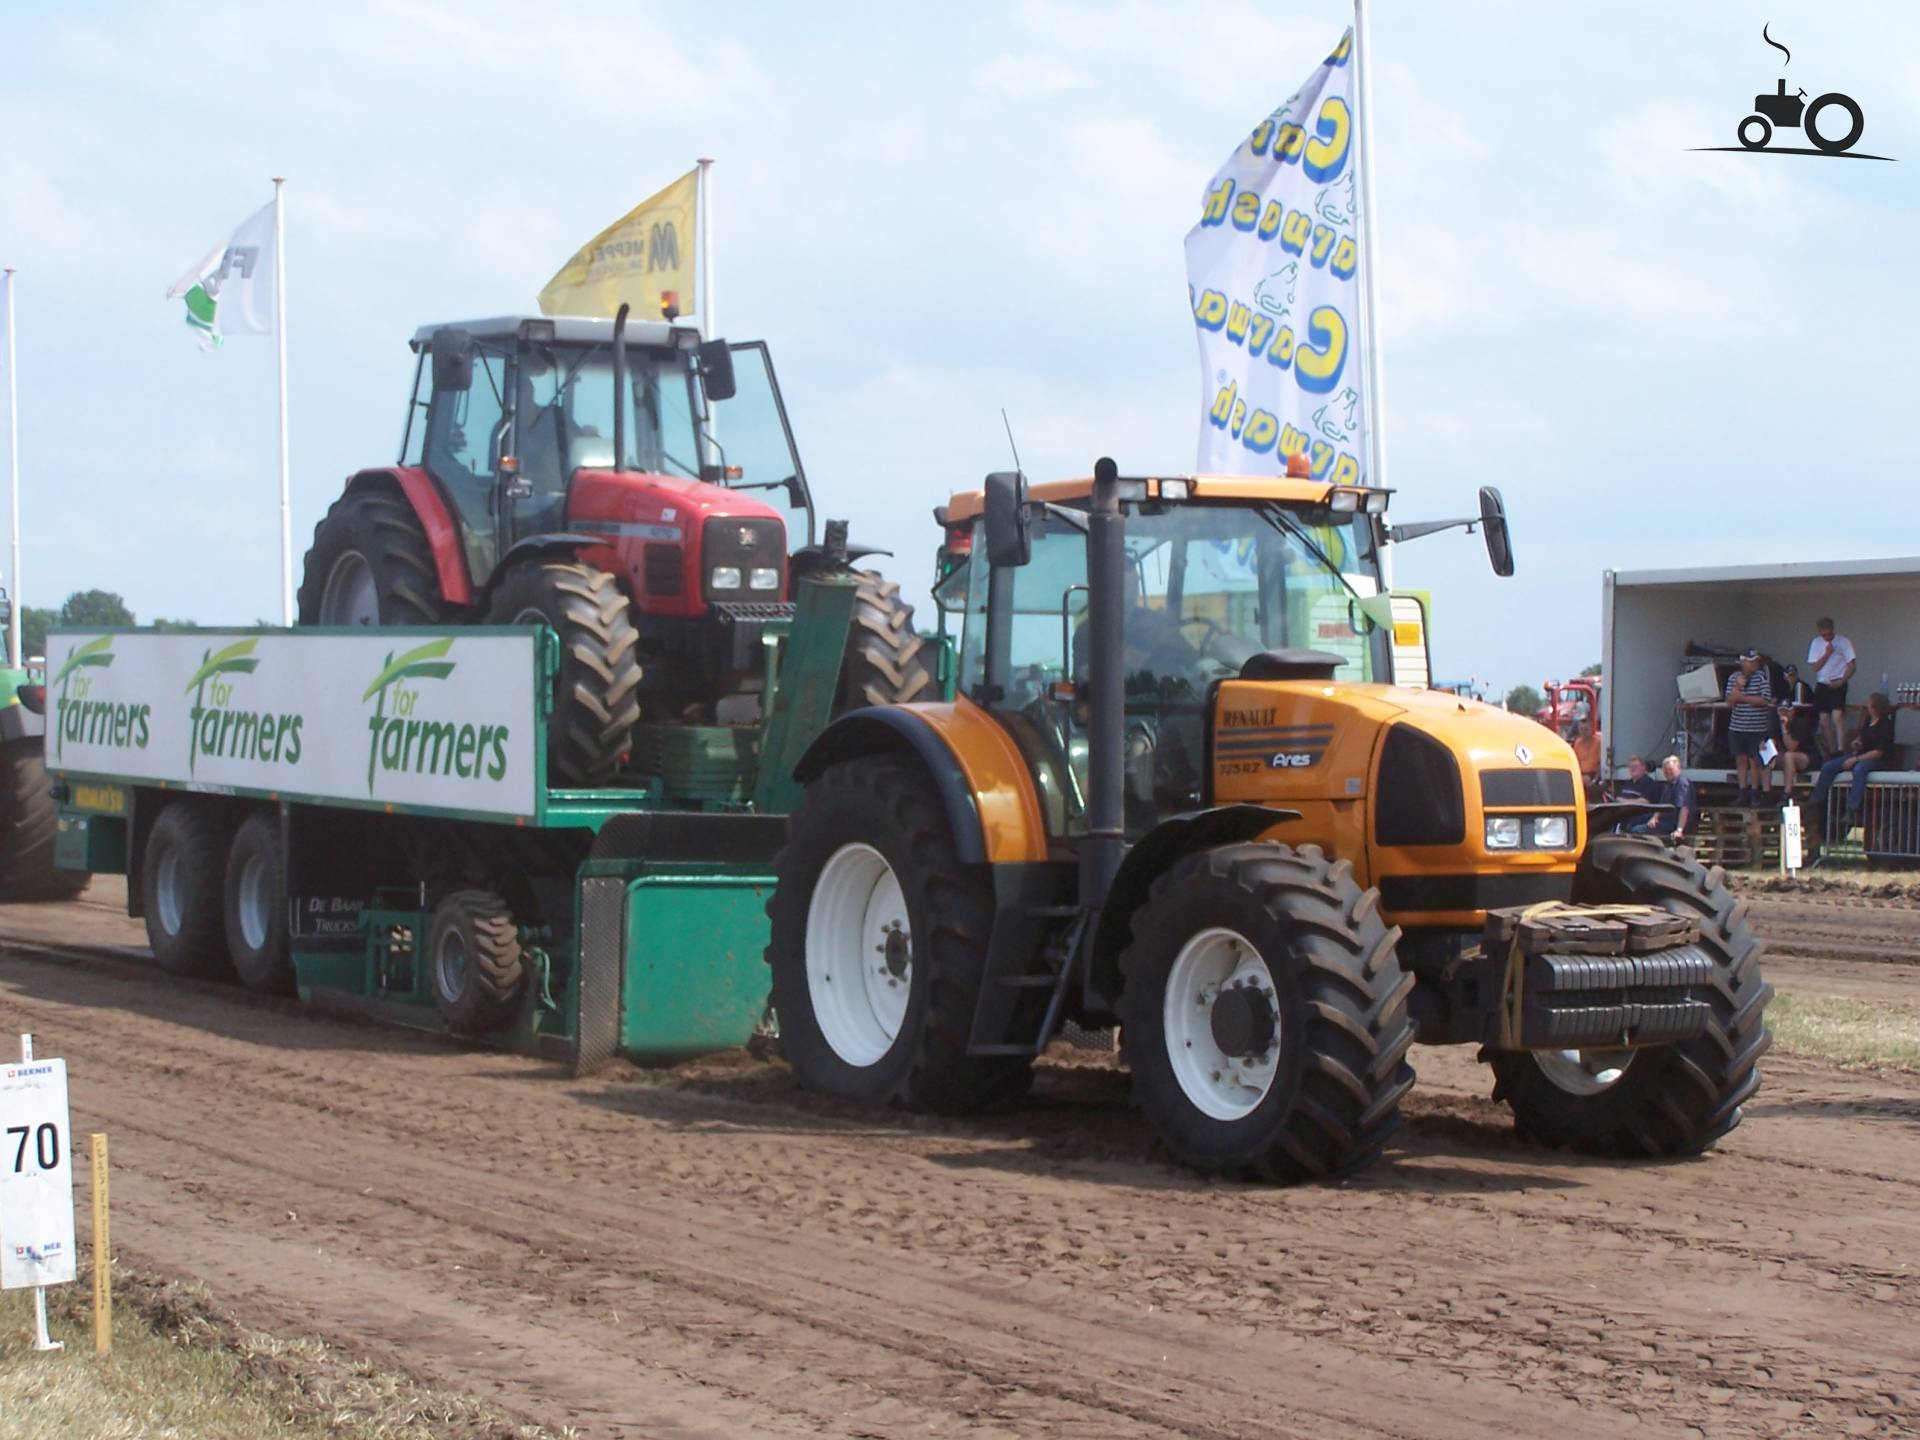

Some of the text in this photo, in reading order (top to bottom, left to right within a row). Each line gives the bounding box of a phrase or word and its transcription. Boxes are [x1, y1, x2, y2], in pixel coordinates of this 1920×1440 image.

[74, 668, 94, 699] for
[210, 671, 234, 707] for
[393, 677, 420, 716] for
[57, 696, 151, 764] farmers
[1223, 707, 1277, 727] RENAULT
[190, 703, 303, 781] farmers
[368, 712, 509, 797] farmers
[1272, 753, 1311, 767] Ares
[6, 1121, 60, 1174] 70
